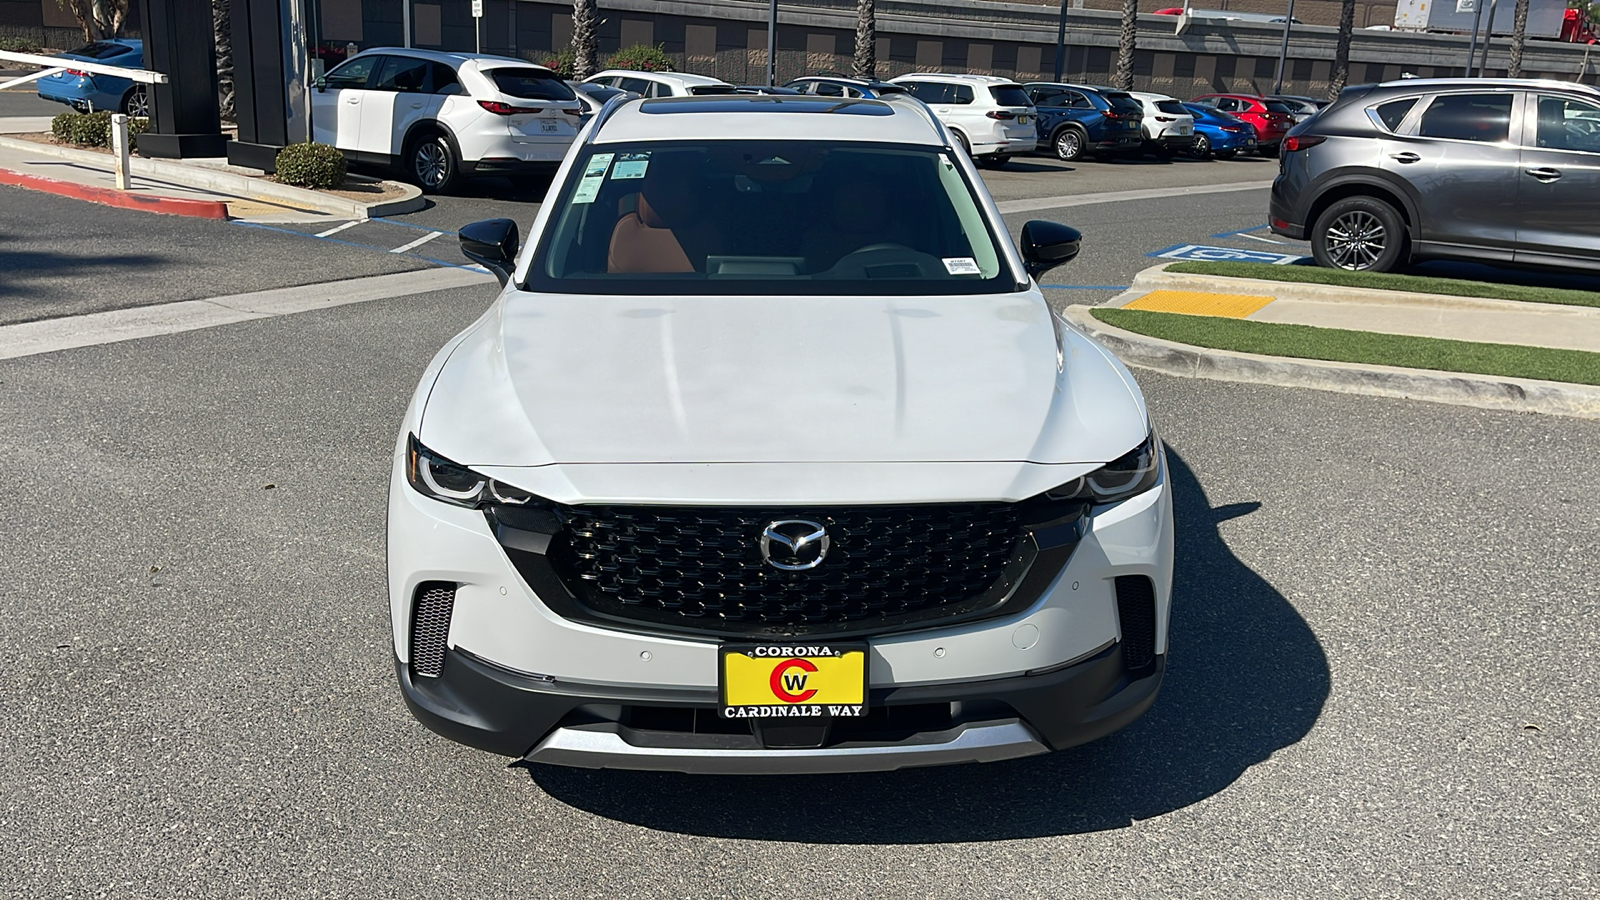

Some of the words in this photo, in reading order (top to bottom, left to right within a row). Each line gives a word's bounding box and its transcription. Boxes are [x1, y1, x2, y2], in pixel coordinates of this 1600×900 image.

[755, 646, 833, 657] CORONA
[724, 706, 822, 718] CARDINALE
[828, 705, 863, 717] WAY
